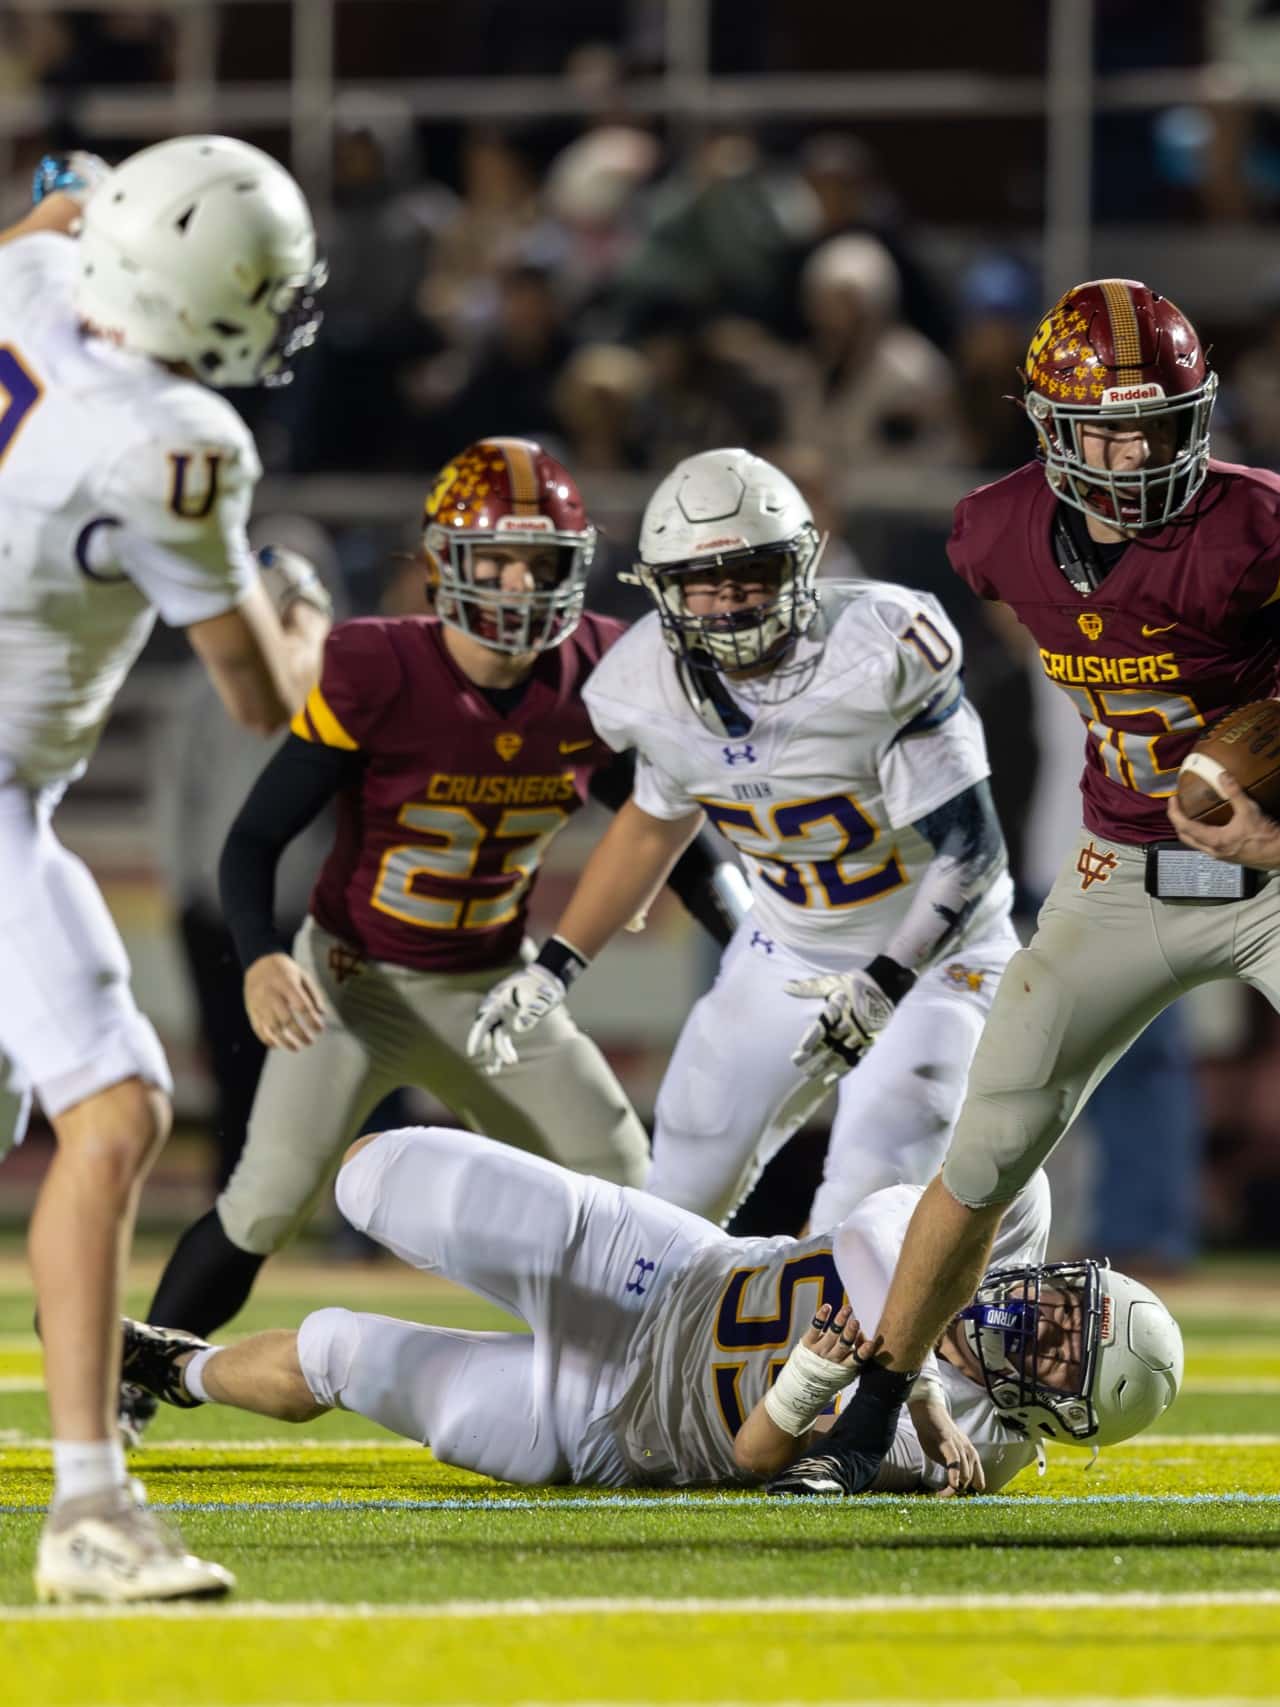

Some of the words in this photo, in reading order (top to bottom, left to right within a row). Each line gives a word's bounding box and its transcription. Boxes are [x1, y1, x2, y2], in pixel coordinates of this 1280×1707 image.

[1109, 387, 1158, 402] Riddell
[168, 453, 226, 520] U
[898, 611, 954, 674] U
[1039, 648, 1180, 684] CRUSHERS
[1056, 684, 1206, 798] 12
[426, 772, 577, 804] CRUSHERS
[369, 803, 569, 930] 23
[695, 791, 911, 911] 52
